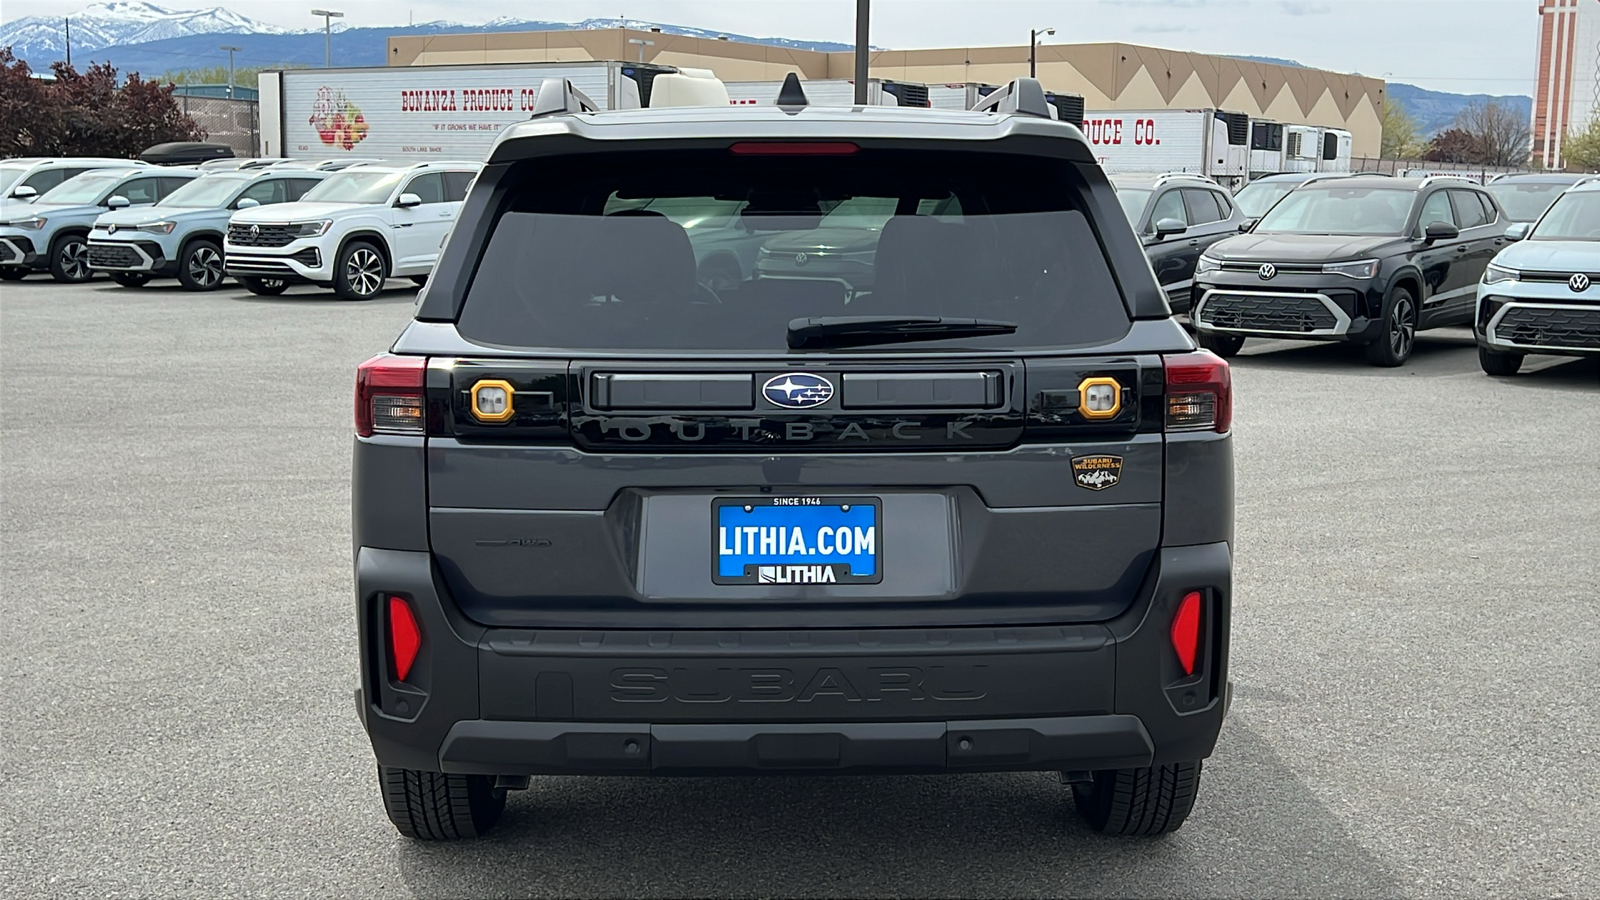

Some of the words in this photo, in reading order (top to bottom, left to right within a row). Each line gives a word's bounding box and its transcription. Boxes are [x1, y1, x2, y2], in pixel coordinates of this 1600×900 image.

[402, 90, 457, 111] BONANZA
[463, 89, 513, 111] PRODUCE
[441, 123, 446, 131] IT
[447, 123, 467, 131] GROWS
[468, 123, 477, 131] WE
[478, 123, 492, 131] HAVE
[1135, 119, 1160, 145] CO.
[618, 421, 973, 441] OUTBACK
[1075, 462, 1120, 470] WILDERNESS
[773, 498, 799, 506] SINCE
[801, 498, 821, 506] 1946
[719, 526, 875, 556] LITHIA.COM
[776, 565, 837, 583] LITHIA
[609, 666, 990, 702] SUBARU
